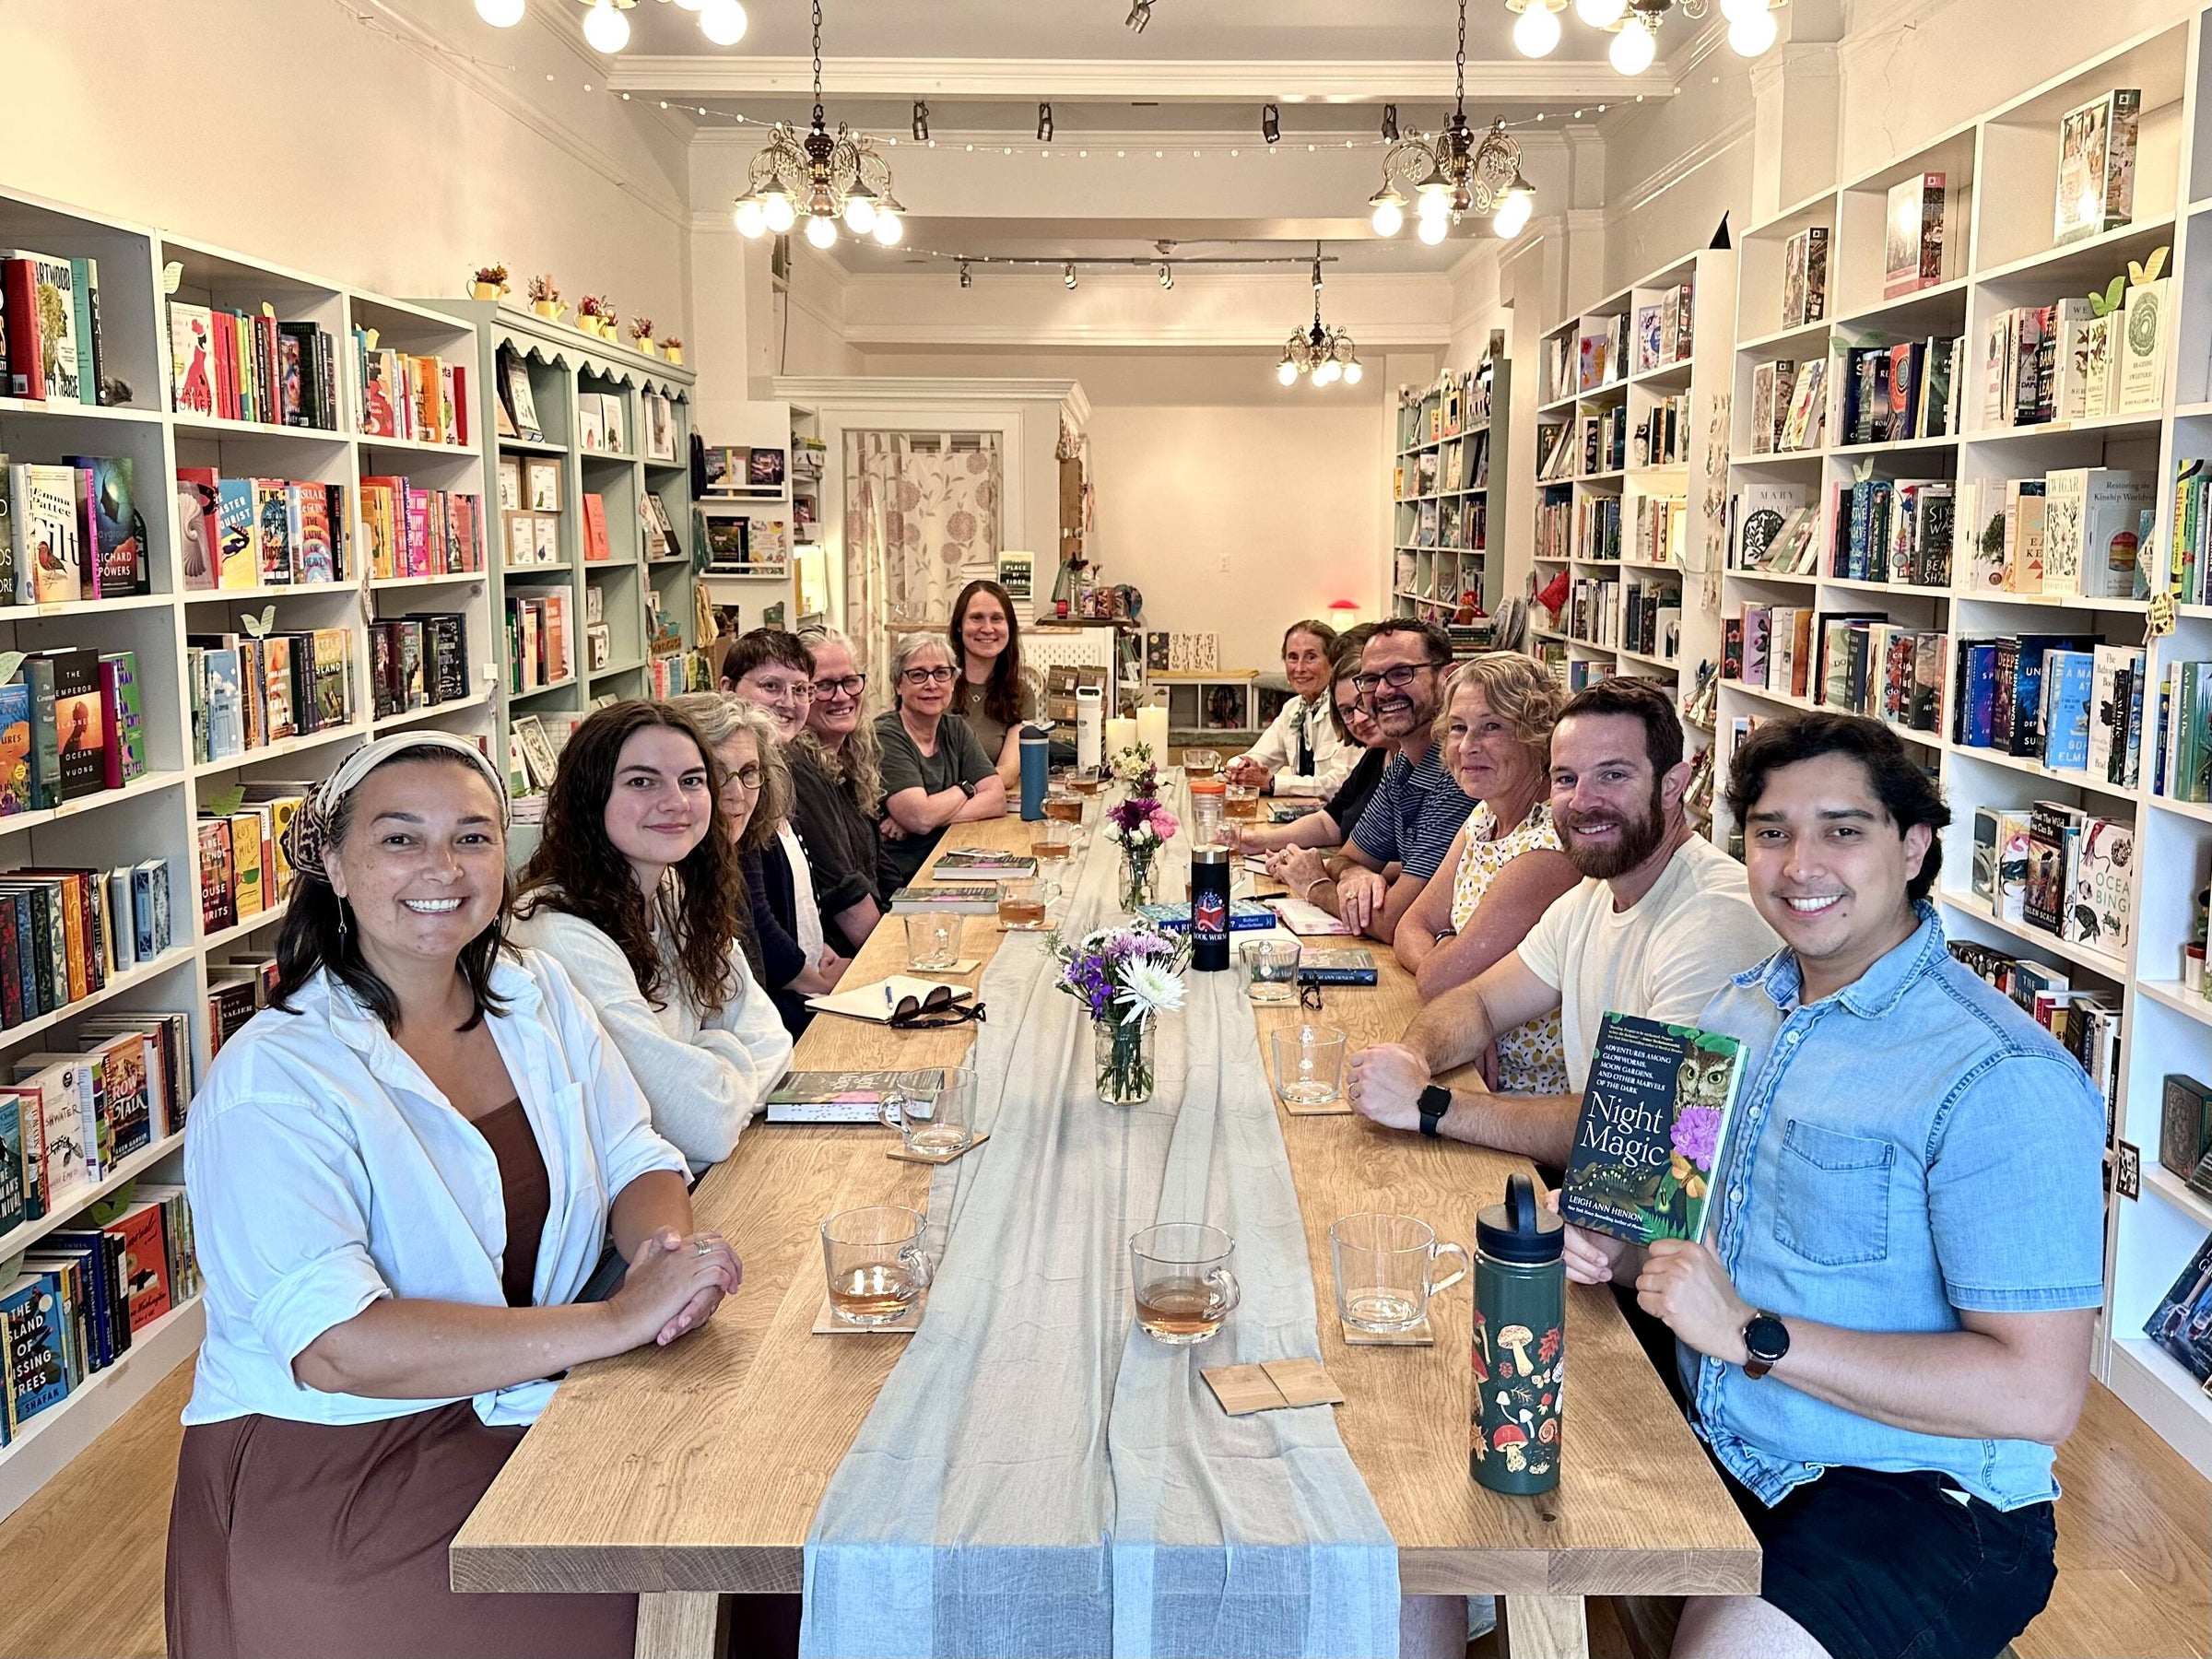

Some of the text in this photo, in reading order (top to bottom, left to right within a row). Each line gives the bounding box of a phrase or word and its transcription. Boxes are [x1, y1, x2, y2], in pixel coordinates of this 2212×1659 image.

[2106, 481, 2139, 491] Restoring
[1760, 490, 1794, 500] MARY
[2094, 493, 2122, 503] Kinship
[99, 565, 131, 577] POWERS
[1998, 652, 2015, 668] DEEP
[65, 670, 80, 678] THE
[56, 685, 92, 697] EMPEROR
[2009, 673, 2018, 738] UNDERWORLD
[65, 750, 92, 761] OCEAN
[65, 765, 93, 778] VUONG
[2043, 813, 2065, 828] The Wild
[2037, 823, 2053, 836] Can Be
[1208, 932, 1227, 941] WORM
[2022, 974, 2035, 990] THE
[1602, 1053, 1647, 1068] GLOWWORMS,
[1604, 1043, 1672, 1065] ADVENTURES AMONG
[1600, 1061, 1654, 1079] MOON GARDENS,
[1595, 1078, 1638, 1095] OF THE DARK
[1597, 1070, 1666, 1091] AND OTHER MARVELS
[1588, 1091, 1663, 1135] Night
[1580, 1120, 1665, 1168] Magic
[1569, 1194, 1643, 1222] LEIGH ANN HENION
[10, 1300, 31, 1319] THE
[17, 1338, 34, 1358] OF
[25, 1387, 60, 1414] SHAFAK
